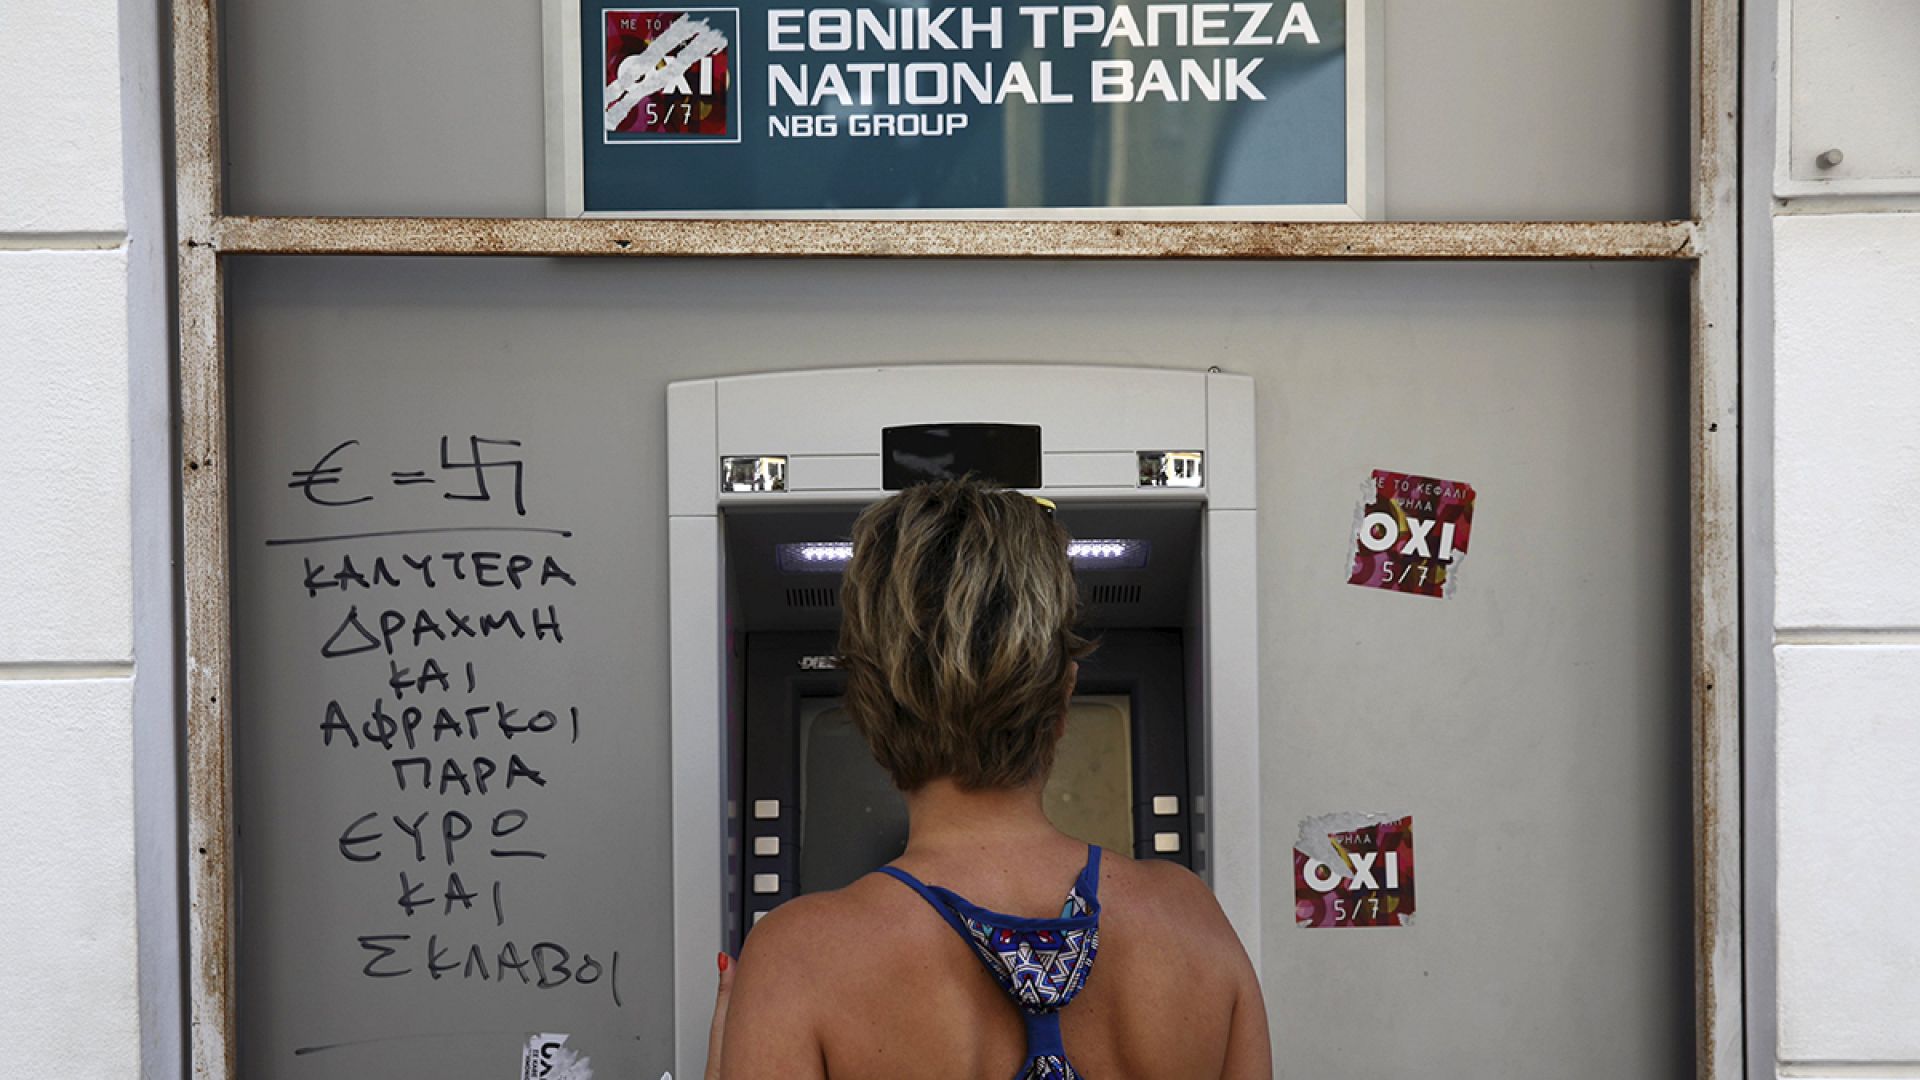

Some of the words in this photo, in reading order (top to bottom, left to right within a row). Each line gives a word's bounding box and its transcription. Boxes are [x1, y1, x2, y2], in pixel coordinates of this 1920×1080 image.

[768, 6, 1003, 52] ΕΘΝΙΚΗ
[1022, 2, 1321, 48] ΤΡΑΠΕΖΑ
[768, 59, 1073, 106] NATIONAL
[1091, 57, 1267, 103] BANK
[646, 104, 692, 125] 5/7
[768, 115, 837, 138] NBG
[848, 113, 968, 137] GROUP
[1359, 512, 1456, 560] ΟΧΙ
[303, 551, 577, 598] ΚΑΛΥΤΕΡΑ
[1382, 562, 1428, 587] 5/7
[321, 605, 564, 658] ΔΡΑΧΜΗ
[389, 658, 475, 699] ΚΑΙ
[320, 698, 580, 749] ΑΦΡΑΓΚΟΙ
[392, 754, 547, 796] ΠΑΡΑ
[398, 871, 504, 926] ΚΑΙ
[1335, 898, 1379, 921] 5/7
[357, 934, 622, 1007] ΣΚΛΑΒΟΙ
